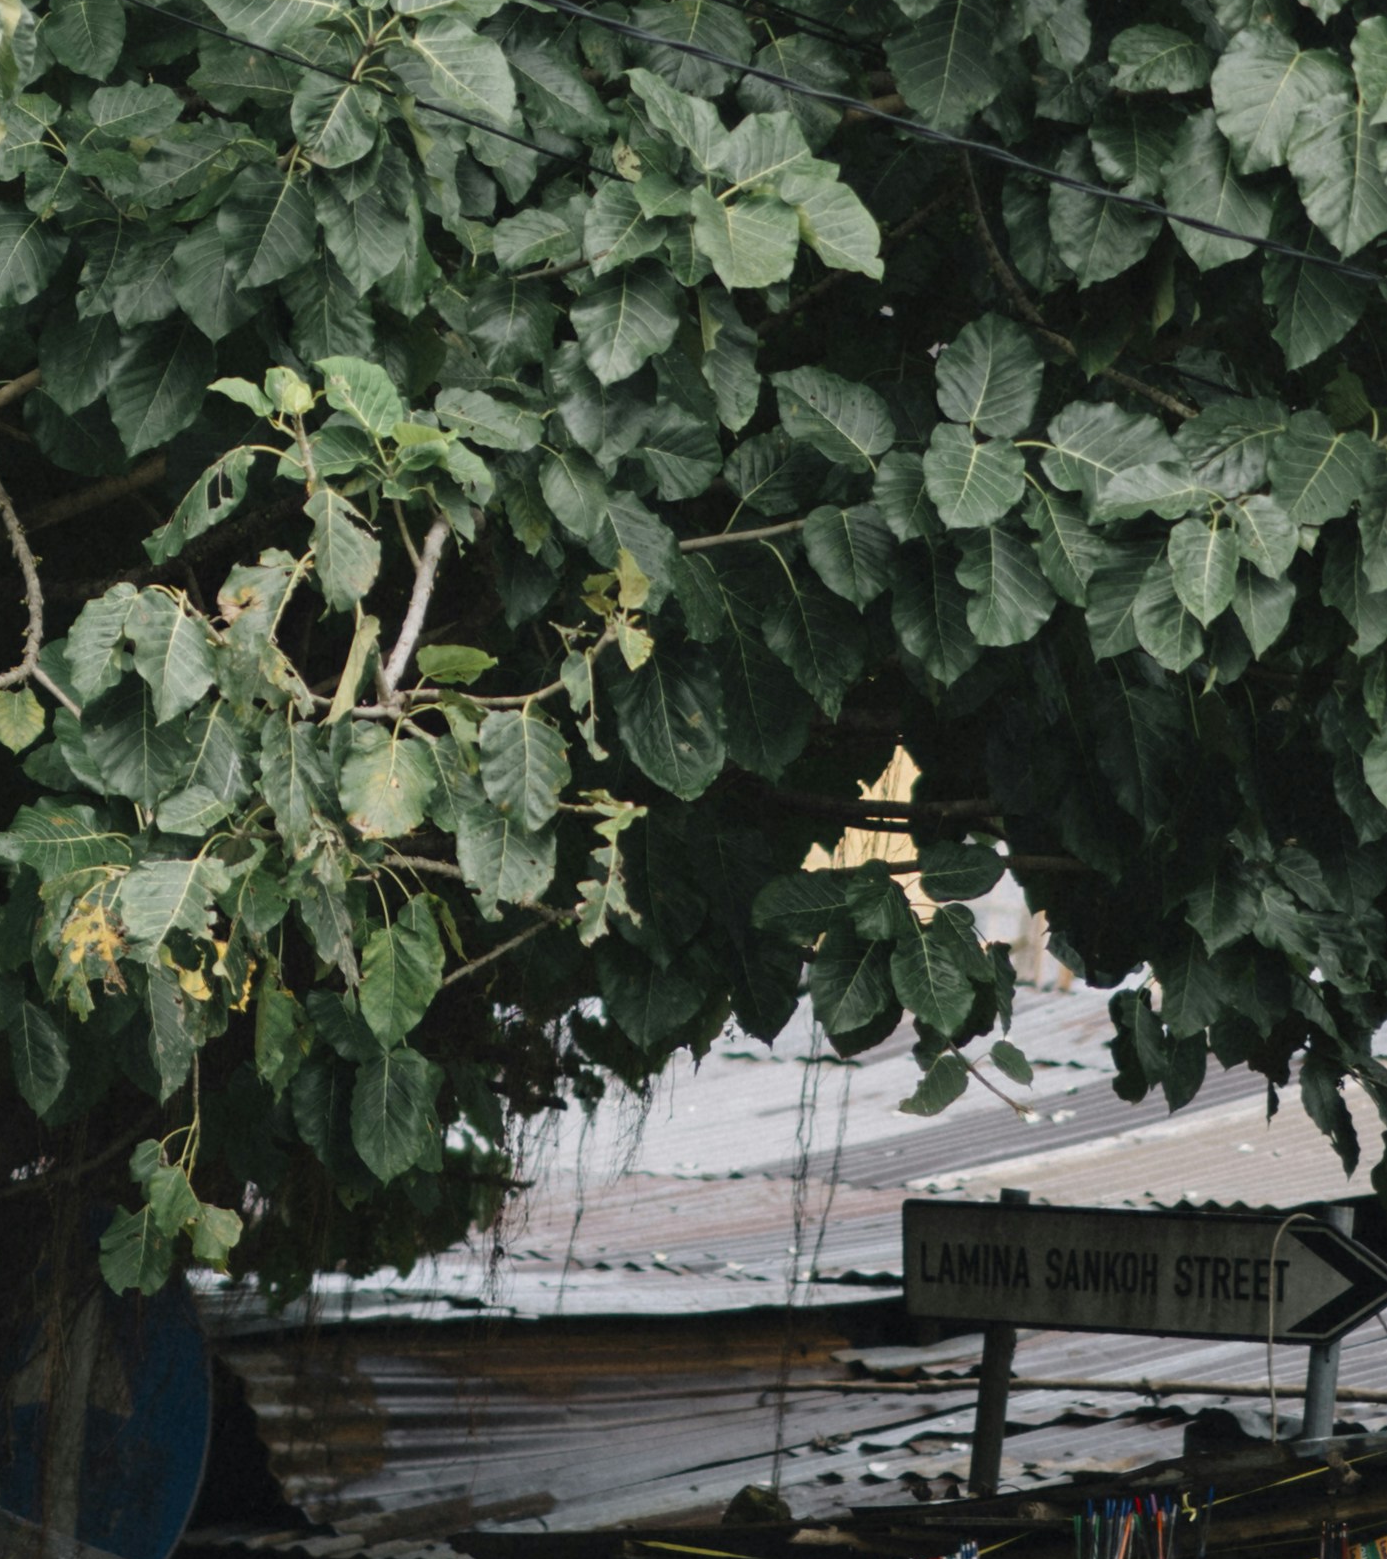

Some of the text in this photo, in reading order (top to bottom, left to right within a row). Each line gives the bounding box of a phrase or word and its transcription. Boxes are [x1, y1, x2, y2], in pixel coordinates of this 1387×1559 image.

[920, 1241, 1290, 1303] LAMINA SANKOH STREET
